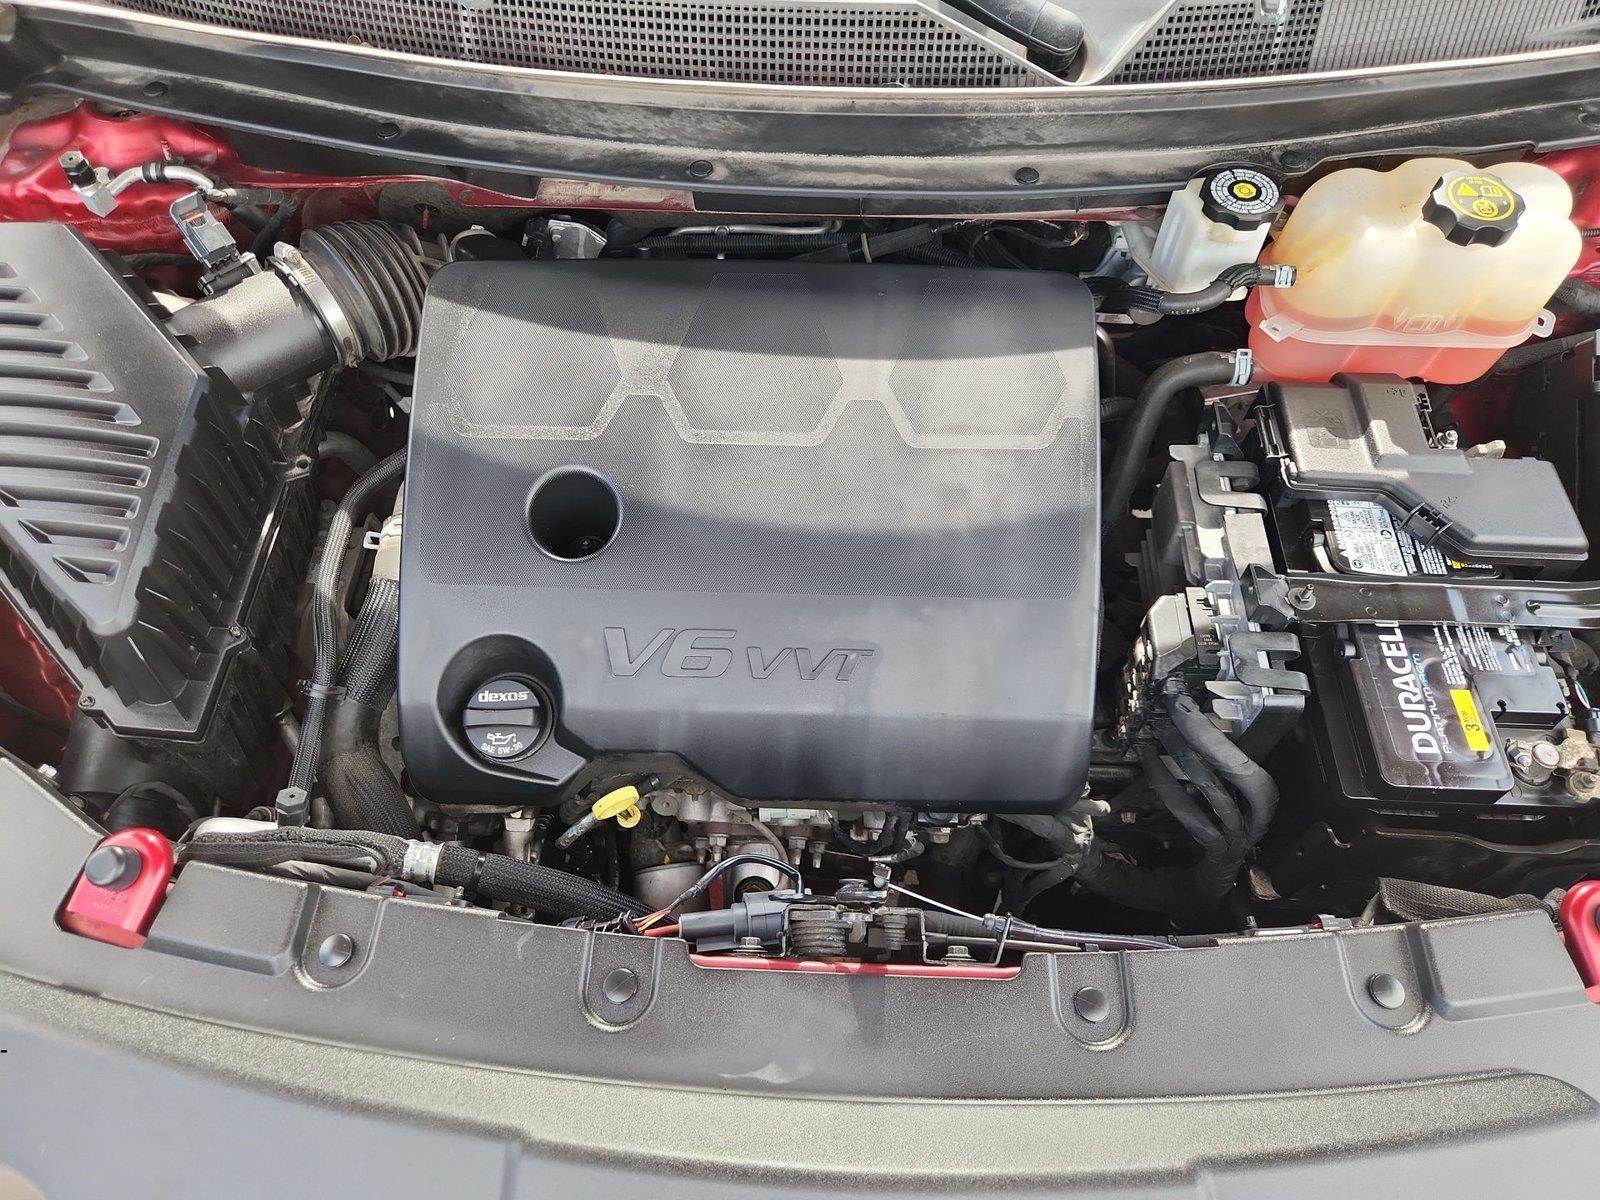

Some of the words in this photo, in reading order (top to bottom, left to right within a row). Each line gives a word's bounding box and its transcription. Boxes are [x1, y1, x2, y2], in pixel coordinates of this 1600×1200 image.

[603, 625, 738, 679] V6
[747, 646, 876, 681] VVT
[1411, 653, 1429, 684] AGM
[478, 690, 530, 703] dexos
[1423, 687, 1452, 754] PLATINUM
[1465, 723, 1480, 732] 3
[481, 743, 496, 754] SAE
[498, 742, 523, 755] 5W-30
